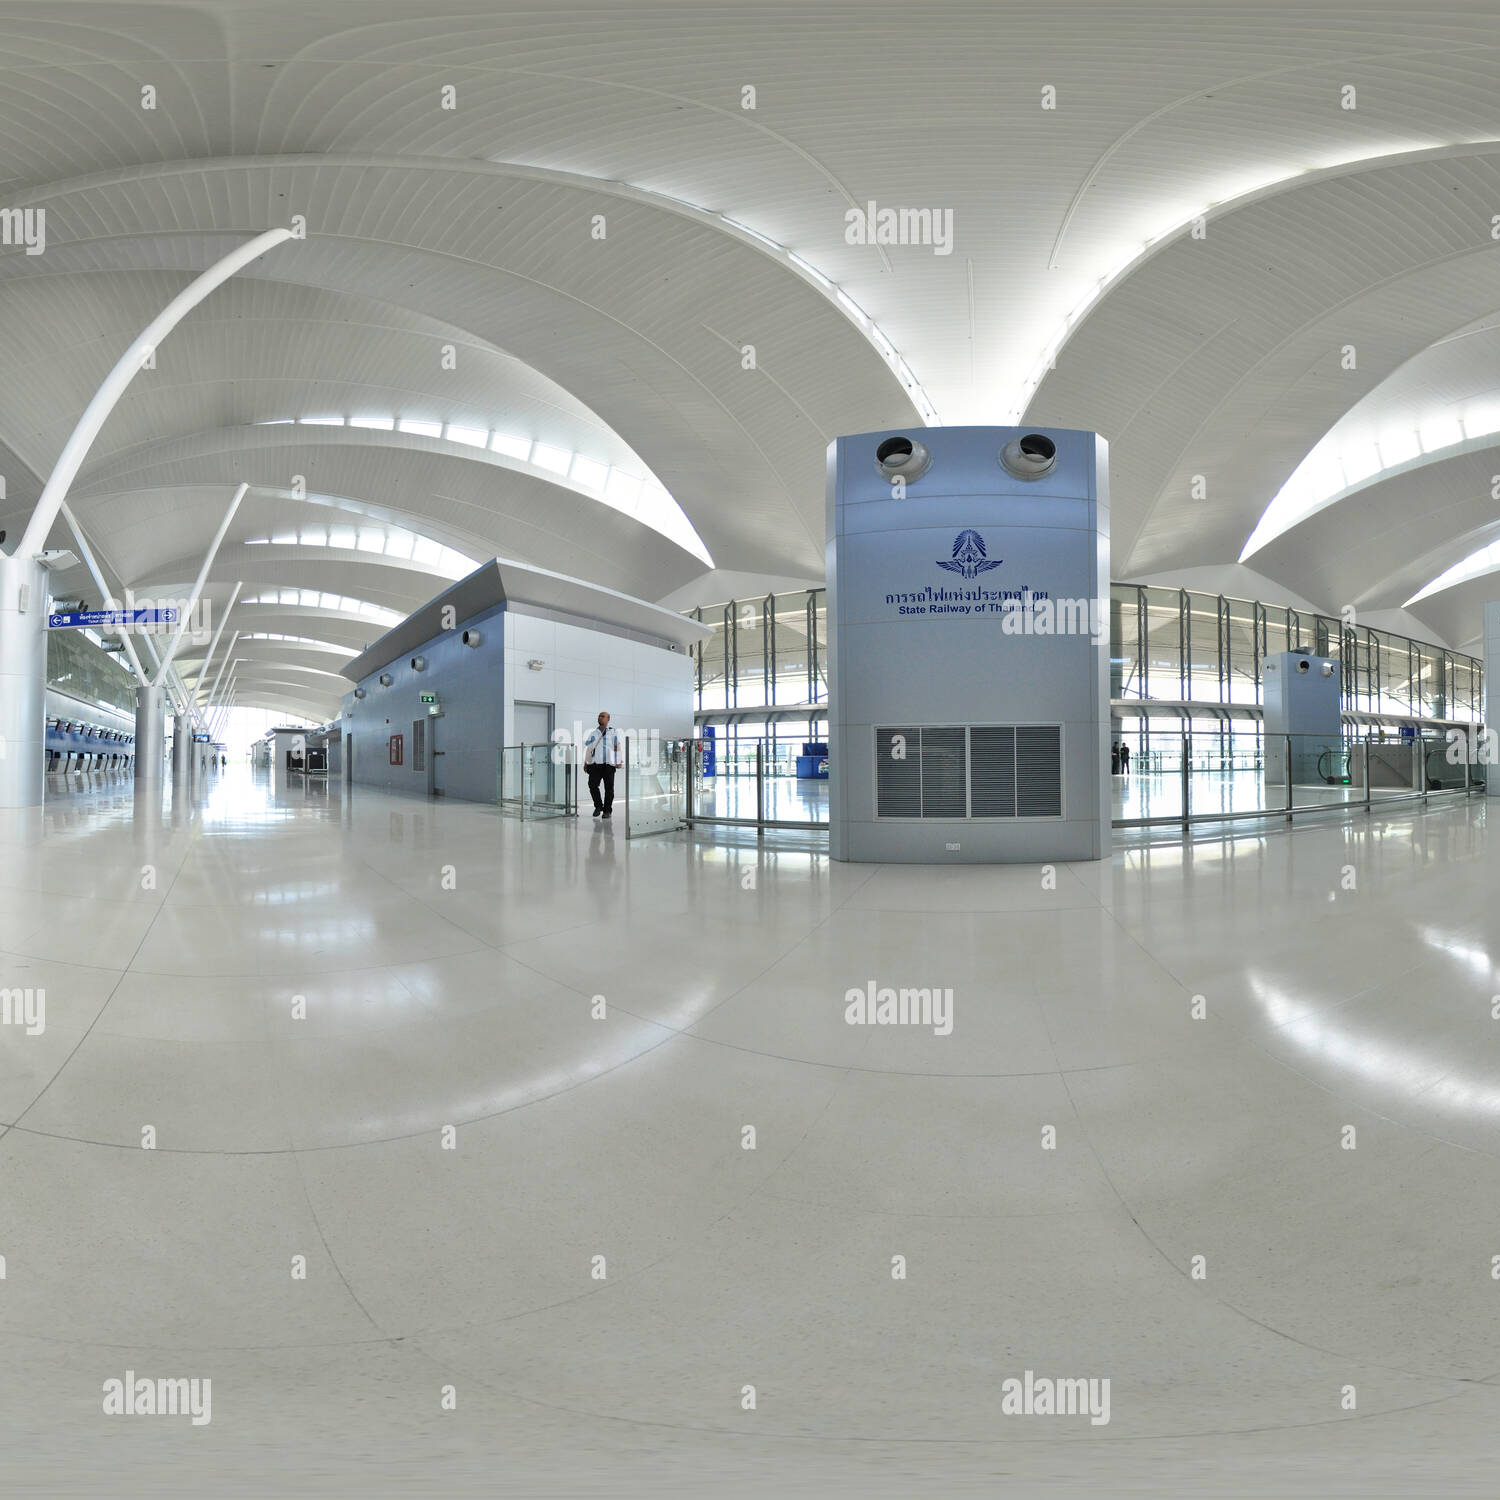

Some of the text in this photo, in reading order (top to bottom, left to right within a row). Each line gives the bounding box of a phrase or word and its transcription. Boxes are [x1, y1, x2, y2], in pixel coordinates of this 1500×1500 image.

[885, 585, 1049, 604] การรถไฟแห่งประเทศไทย
[899, 603, 1036, 615] State Railway of Thailand
